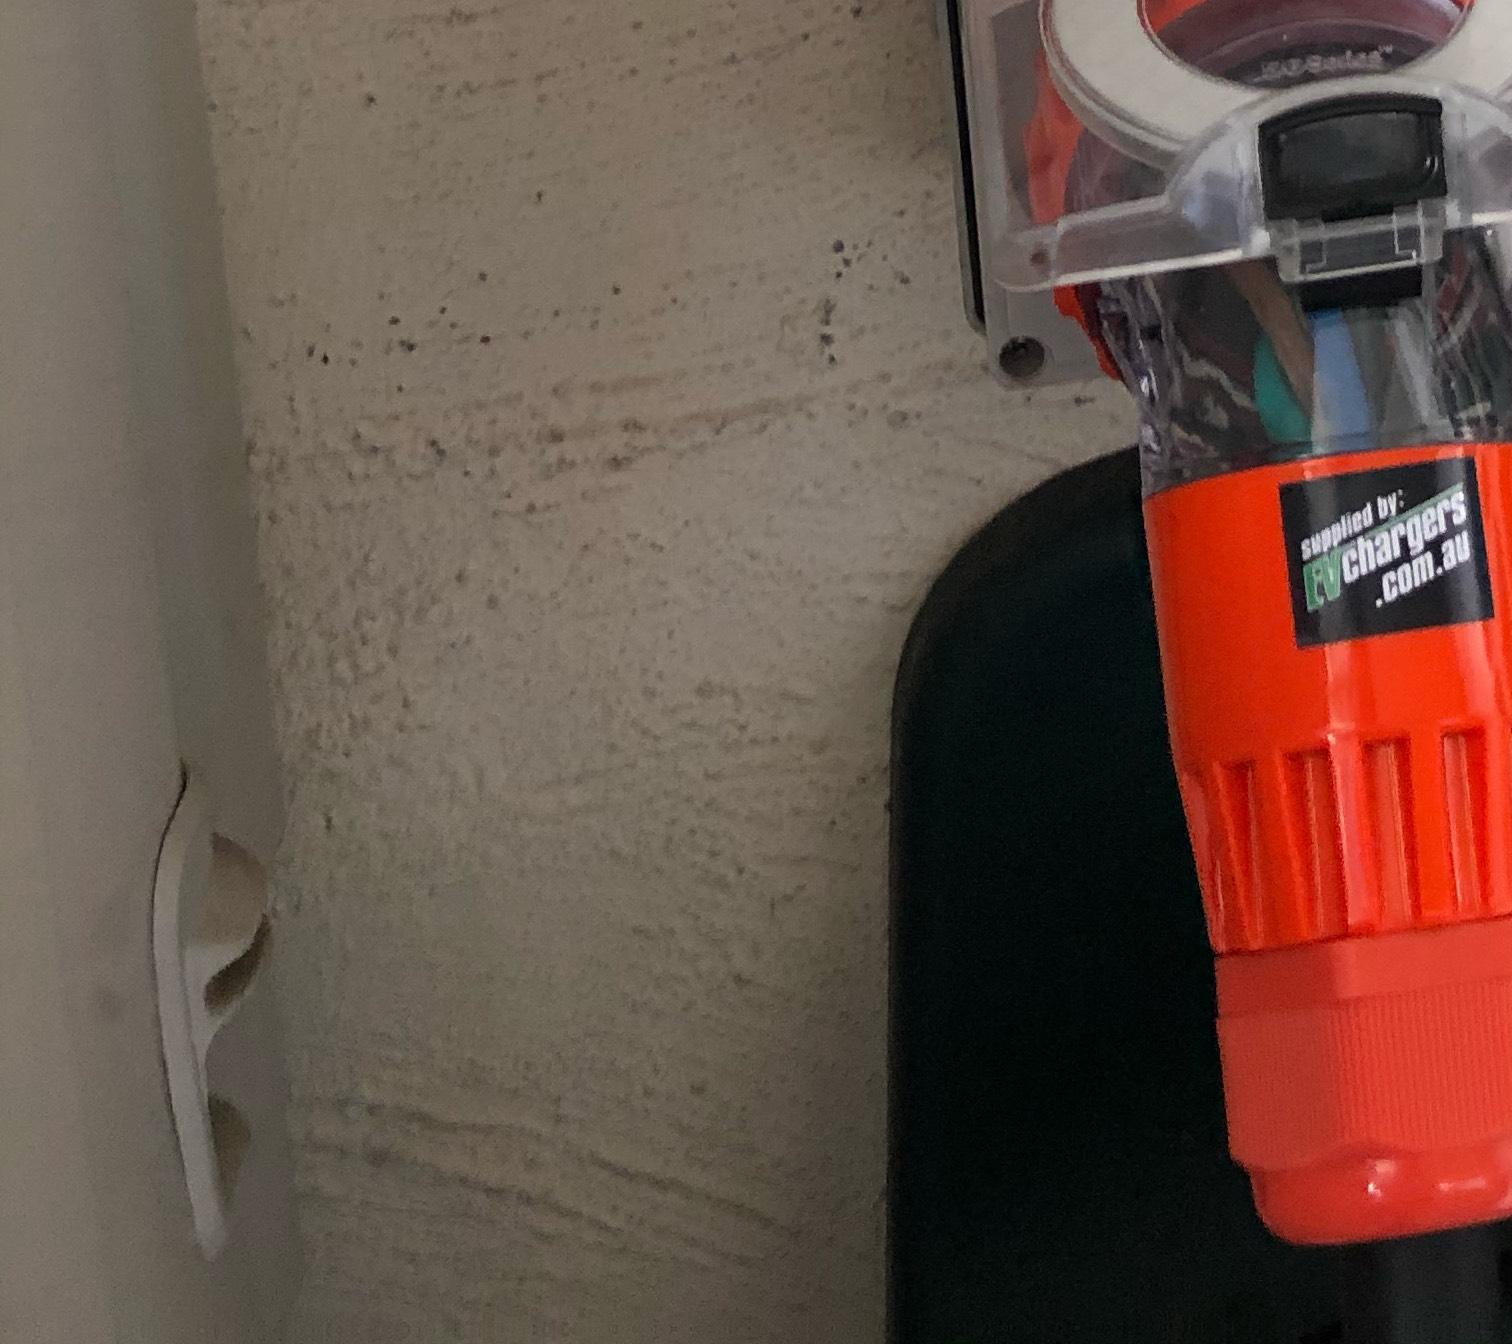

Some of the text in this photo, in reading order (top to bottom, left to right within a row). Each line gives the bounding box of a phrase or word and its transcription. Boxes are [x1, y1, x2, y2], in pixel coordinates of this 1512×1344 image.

[1301, 489, 1405, 561] supplied by:
[1375, 529, 1471, 609] .com.au
